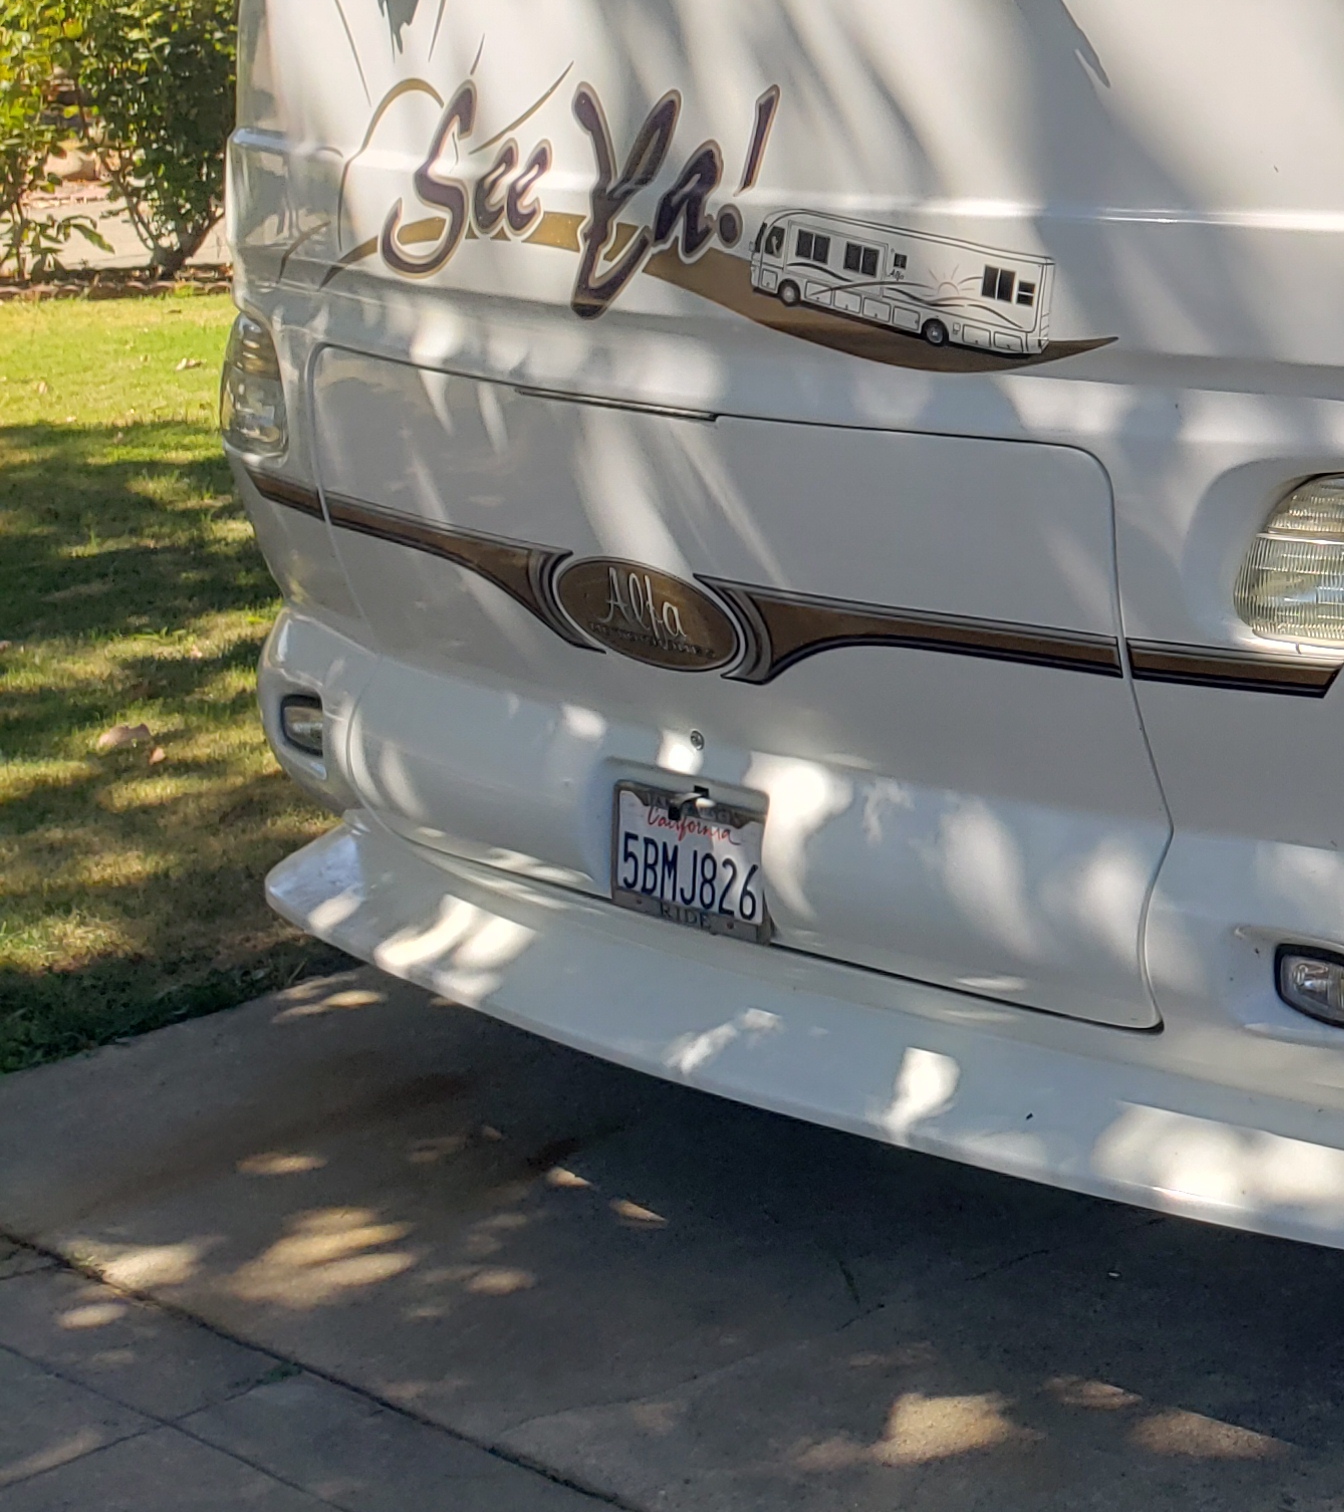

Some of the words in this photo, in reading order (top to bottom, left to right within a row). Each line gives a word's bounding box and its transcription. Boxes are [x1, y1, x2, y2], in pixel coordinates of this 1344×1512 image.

[380, 79, 552, 278] See
[571, 82, 781, 319] Ya!
[604, 567, 688, 640] Alfa
[647, 804, 741, 846] Caifornia
[622, 832, 759, 922] 5BMJ826
[660, 901, 712, 930] RIDE
